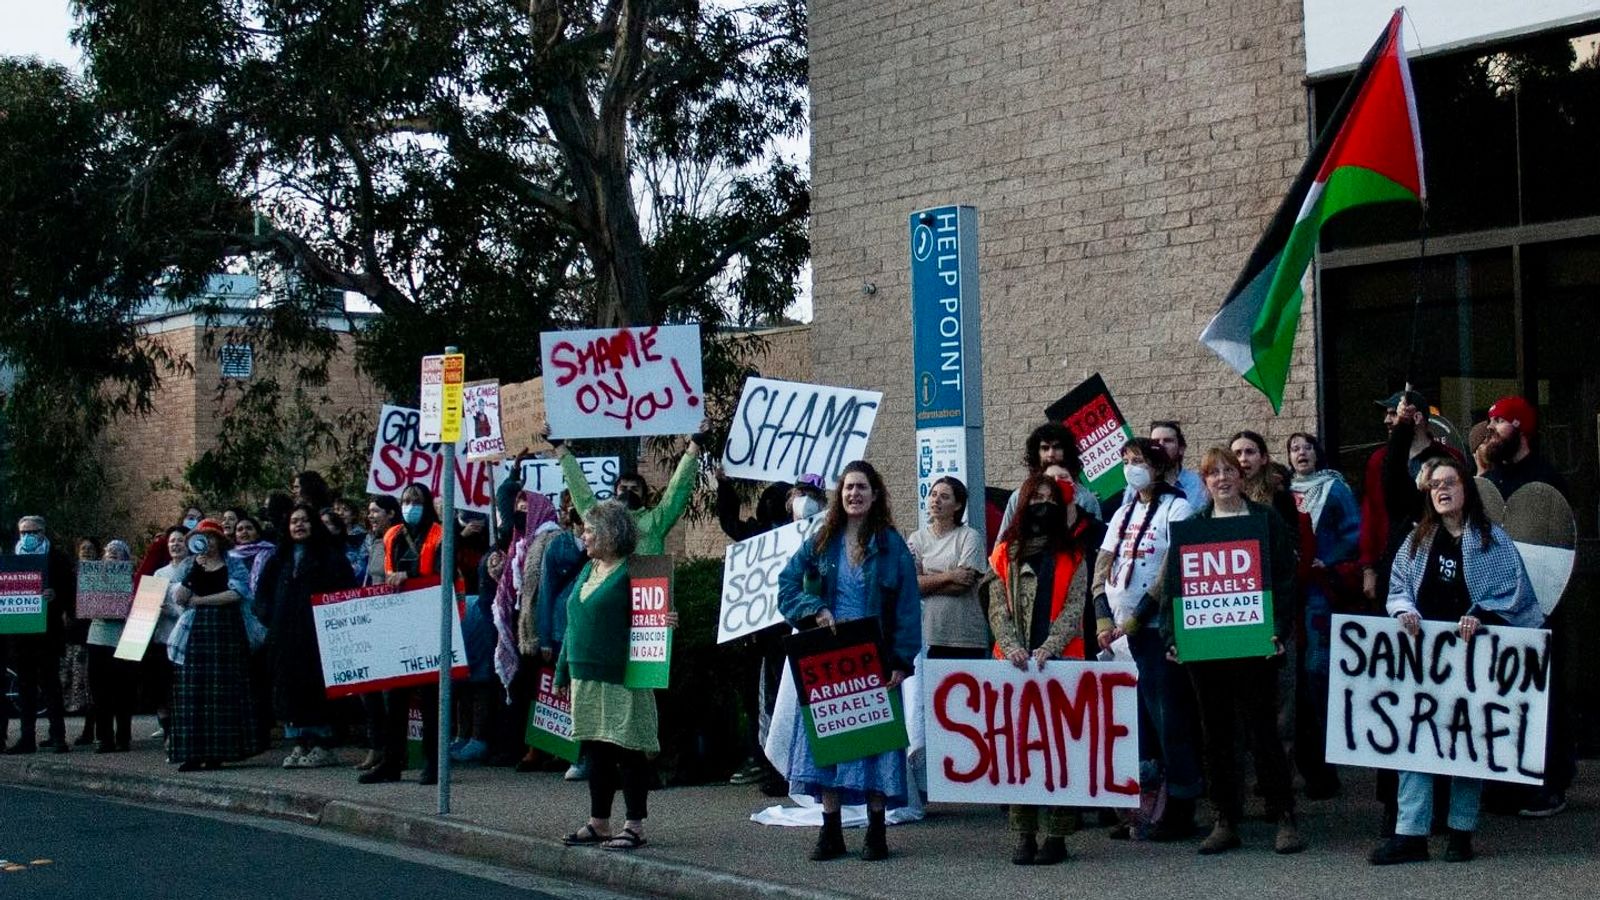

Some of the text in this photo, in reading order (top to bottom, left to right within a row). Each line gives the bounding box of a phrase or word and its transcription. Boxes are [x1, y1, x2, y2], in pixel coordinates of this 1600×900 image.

[937, 213, 961, 390] HELP POINT
[551, 326, 663, 387] SHAME
[576, 371, 628, 414] ON
[382, 410, 440, 454] GR
[726, 386, 877, 482] SHAME
[1077, 419, 1117, 452] RMING
[1082, 432, 1125, 466] SRAEL'S
[1086, 450, 1121, 478] GENOCI
[373, 443, 500, 507] SPINE
[730, 531, 786, 572] PULL
[1182, 549, 1251, 578] END
[322, 589, 361, 604] ONE-WAY
[631, 586, 665, 611] END
[726, 561, 781, 603] SOC
[1184, 577, 1256, 596] ISRAEL'S
[1185, 595, 1259, 610] BLOCKADE
[1186, 610, 1259, 626] OF GAZA
[631, 613, 666, 627] ISRAEL'S
[631, 631, 665, 642] GENOCIDE
[332, 650, 458, 683] HOBART THE HAE
[631, 646, 664, 657] IN GAZA
[1340, 620, 1552, 697] SANCTION
[803, 652, 873, 685] STOP
[810, 674, 880, 702] ARMING
[536, 706, 573, 726] GENOCID
[813, 692, 885, 719] ISRAEL'S
[817, 708, 890, 734] GENOCIDE
[933, 671, 1141, 797] SHAME
[1344, 687, 1545, 779] ISRAEL
